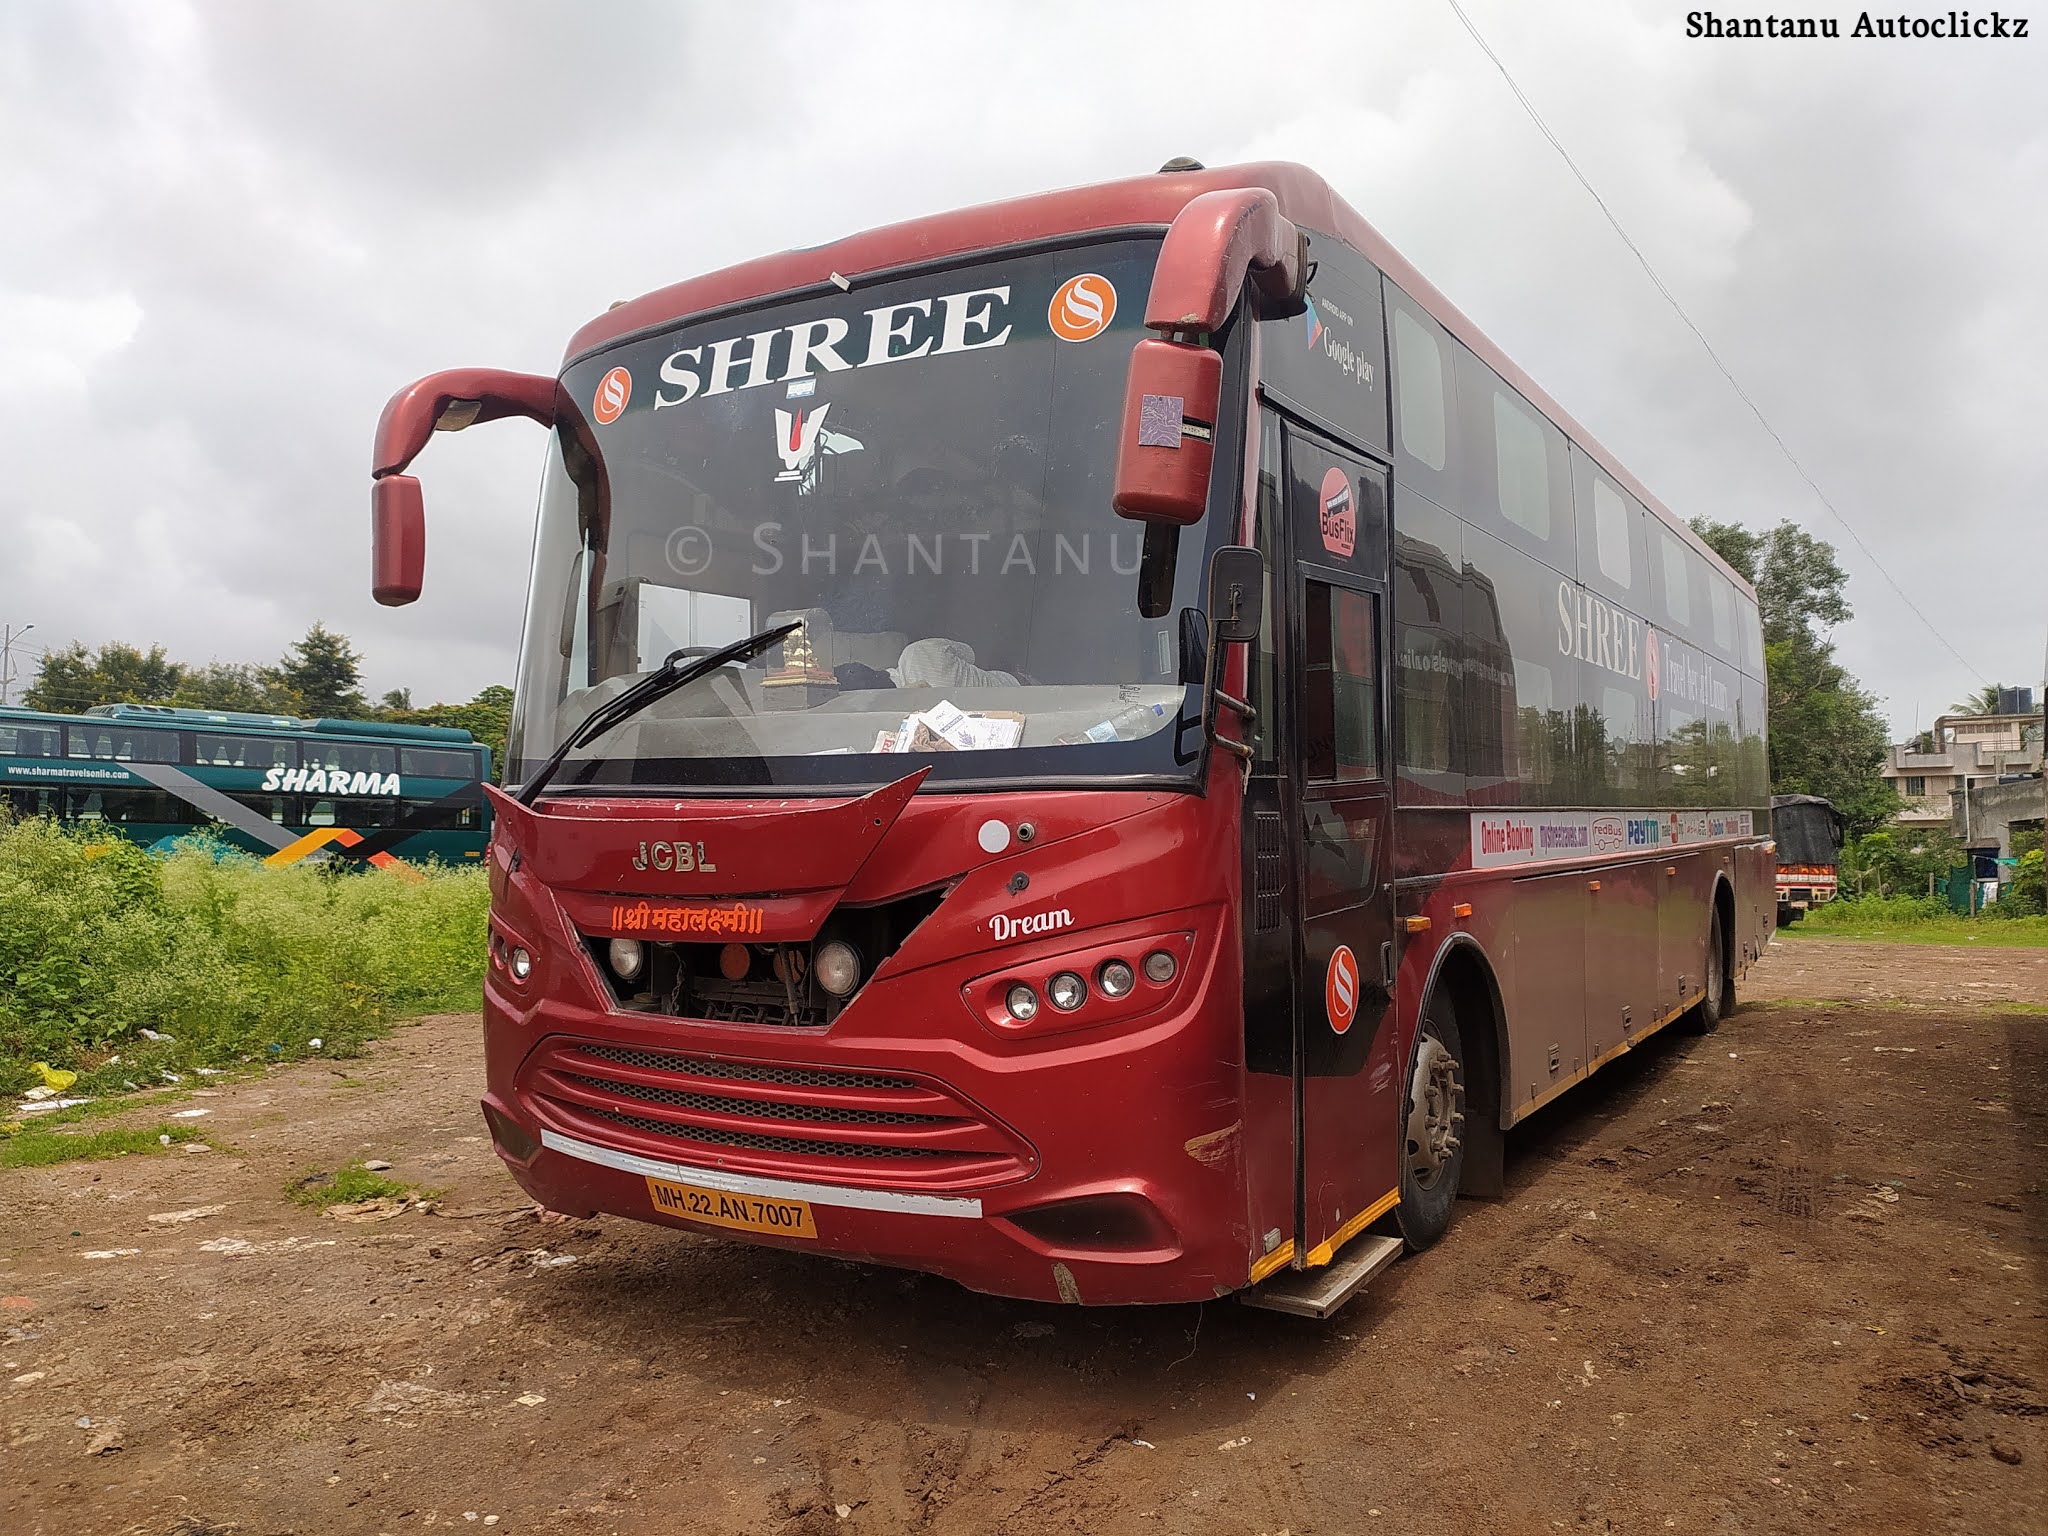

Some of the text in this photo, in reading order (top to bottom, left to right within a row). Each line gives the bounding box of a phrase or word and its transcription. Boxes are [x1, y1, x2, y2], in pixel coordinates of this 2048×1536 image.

[653, 285, 1013, 411] SHREE
[1323, 326, 1375, 392] Google play
[1321, 511, 1354, 545] BusFlix
[1558, 580, 1641, 681] SHREE
[262, 768, 401, 796] SHARMA
[1481, 819, 1534, 857] Online Booking
[1594, 823, 1622, 836] redBus
[632, 840, 717, 873] JCBL
[988, 908, 1076, 941] Dream
[653, 1184, 804, 1228] MH.22.AN.7007
